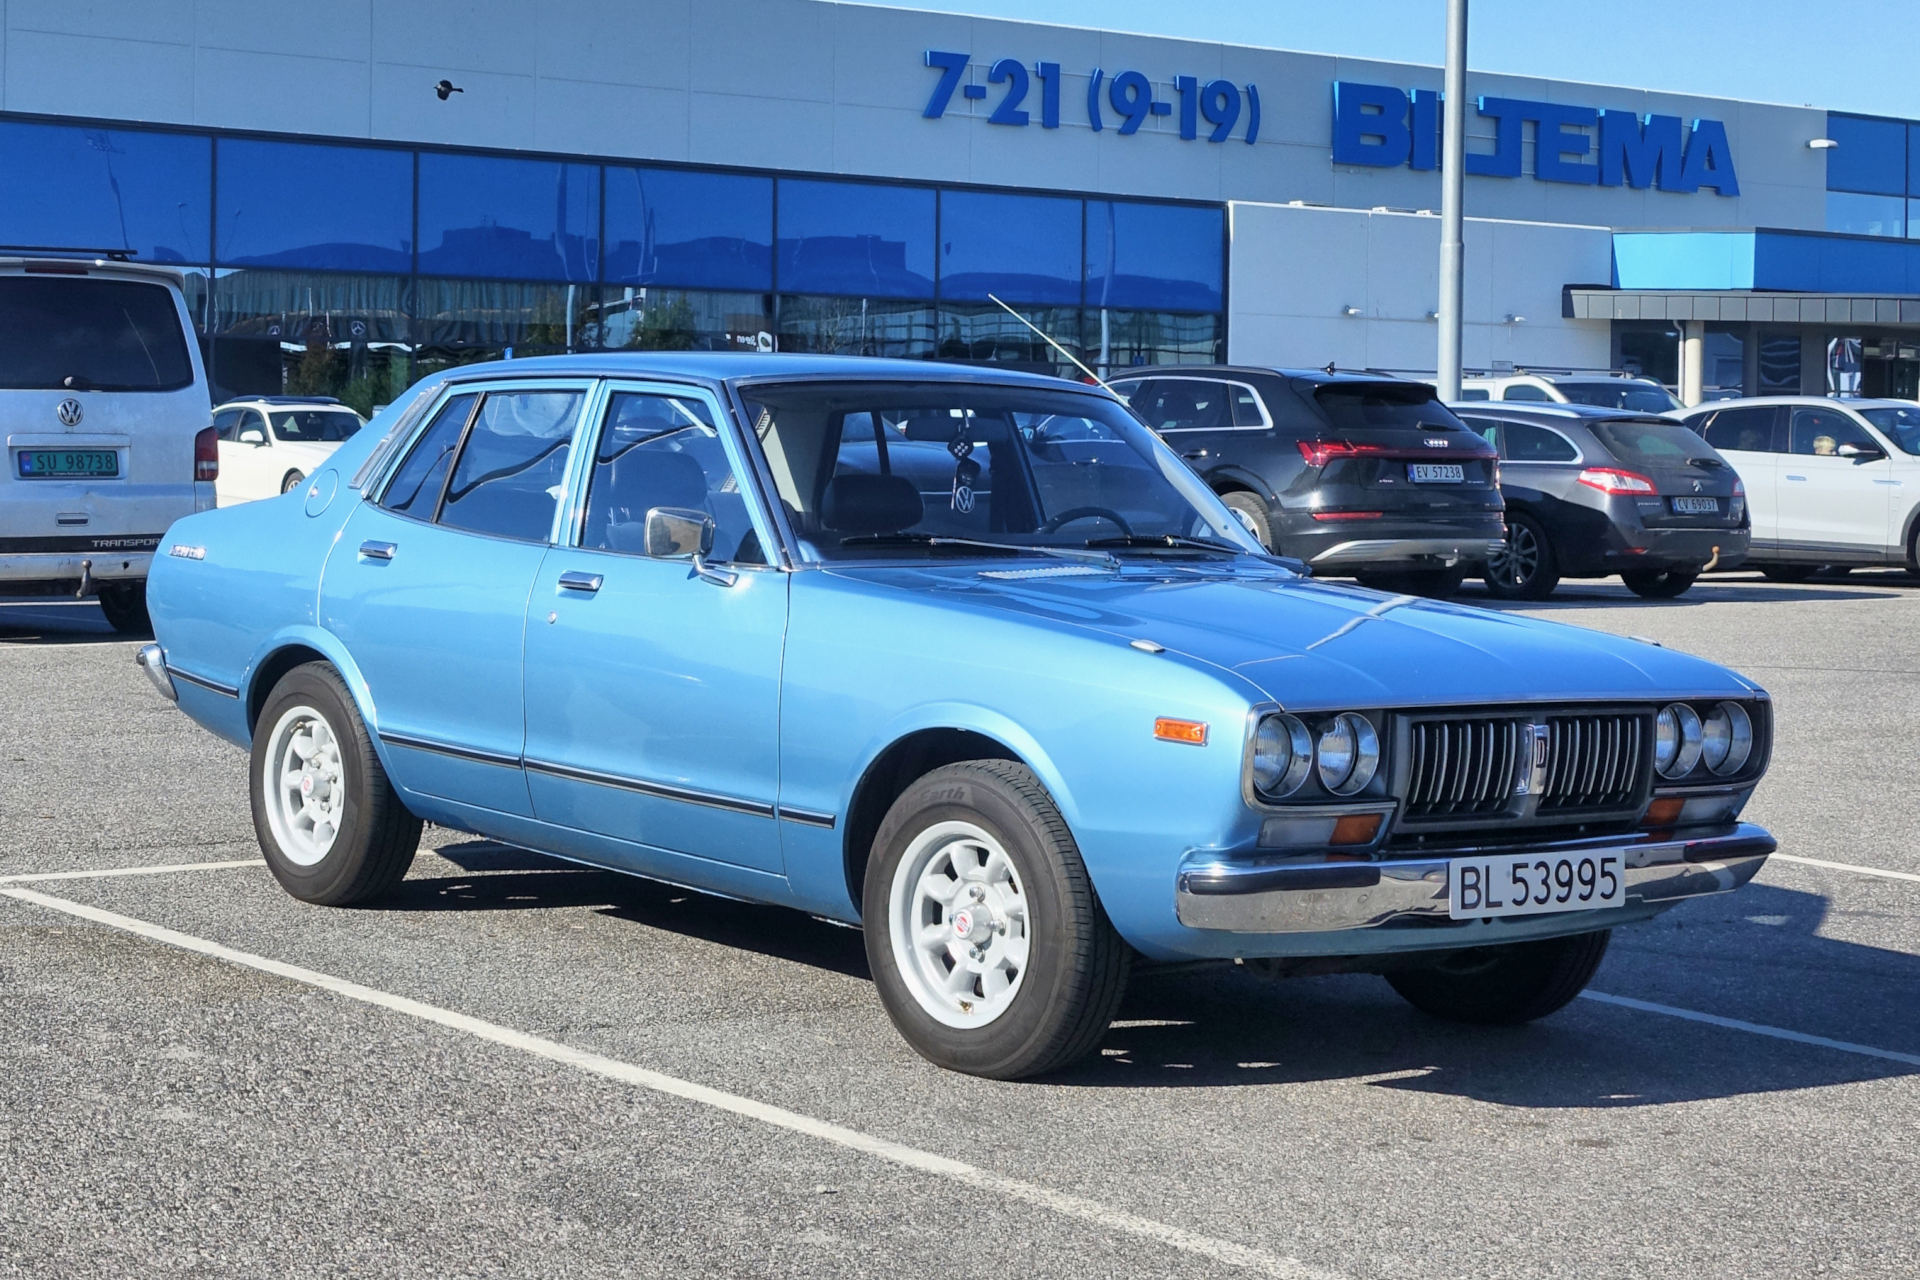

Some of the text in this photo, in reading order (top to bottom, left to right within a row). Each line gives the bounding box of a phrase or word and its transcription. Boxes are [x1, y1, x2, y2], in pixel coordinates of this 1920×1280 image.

[922, 50, 1260, 145] 7-21 (9-19)
[37, 455, 56, 469] SU
[66, 455, 113, 469] 98738
[1416, 466, 1428, 478] EV
[1433, 466, 1461, 479] 57238
[1678, 498, 1688, 510] CV
[1461, 857, 1617, 910] BL 53995
